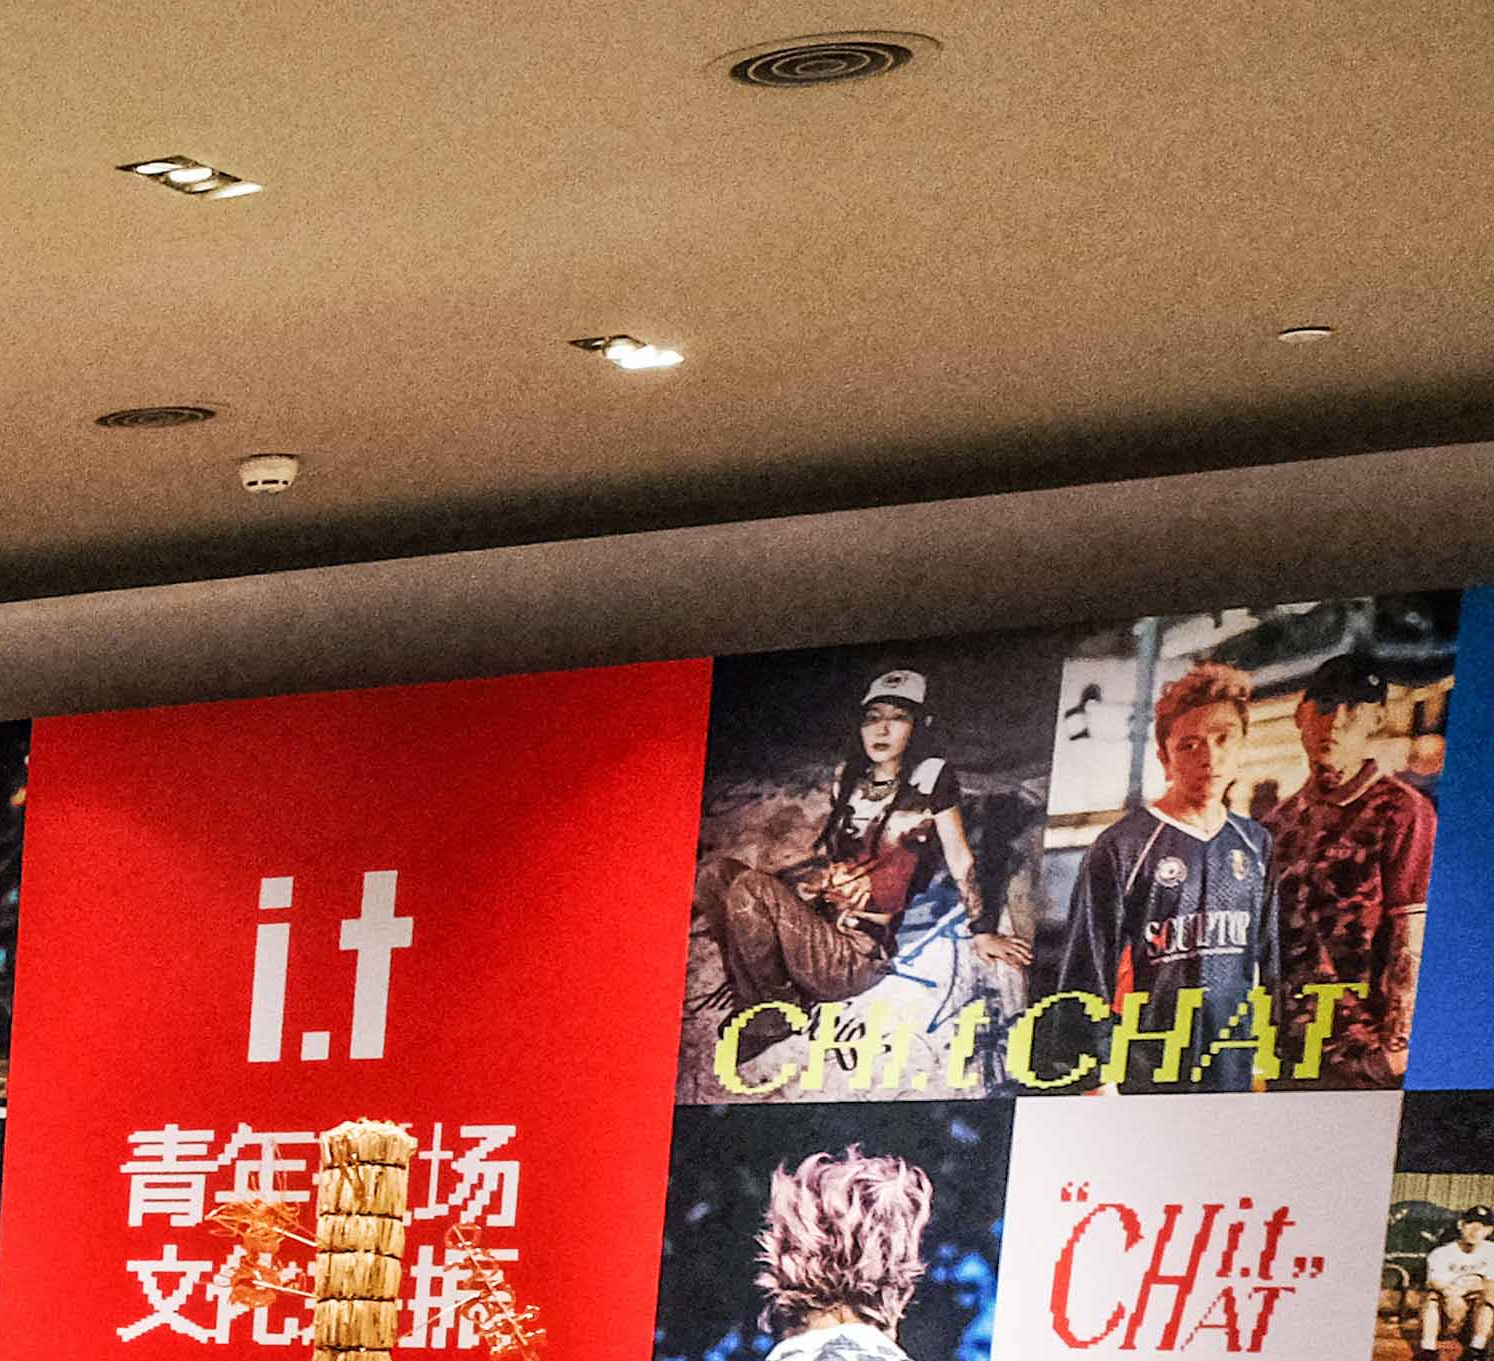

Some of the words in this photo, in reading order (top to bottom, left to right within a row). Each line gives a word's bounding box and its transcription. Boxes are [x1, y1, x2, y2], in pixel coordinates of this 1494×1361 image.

[248, 870, 414, 1063] i.t
[120, 1123, 521, 1228] 青年场
[116, 1243, 520, 1350] 文化振
